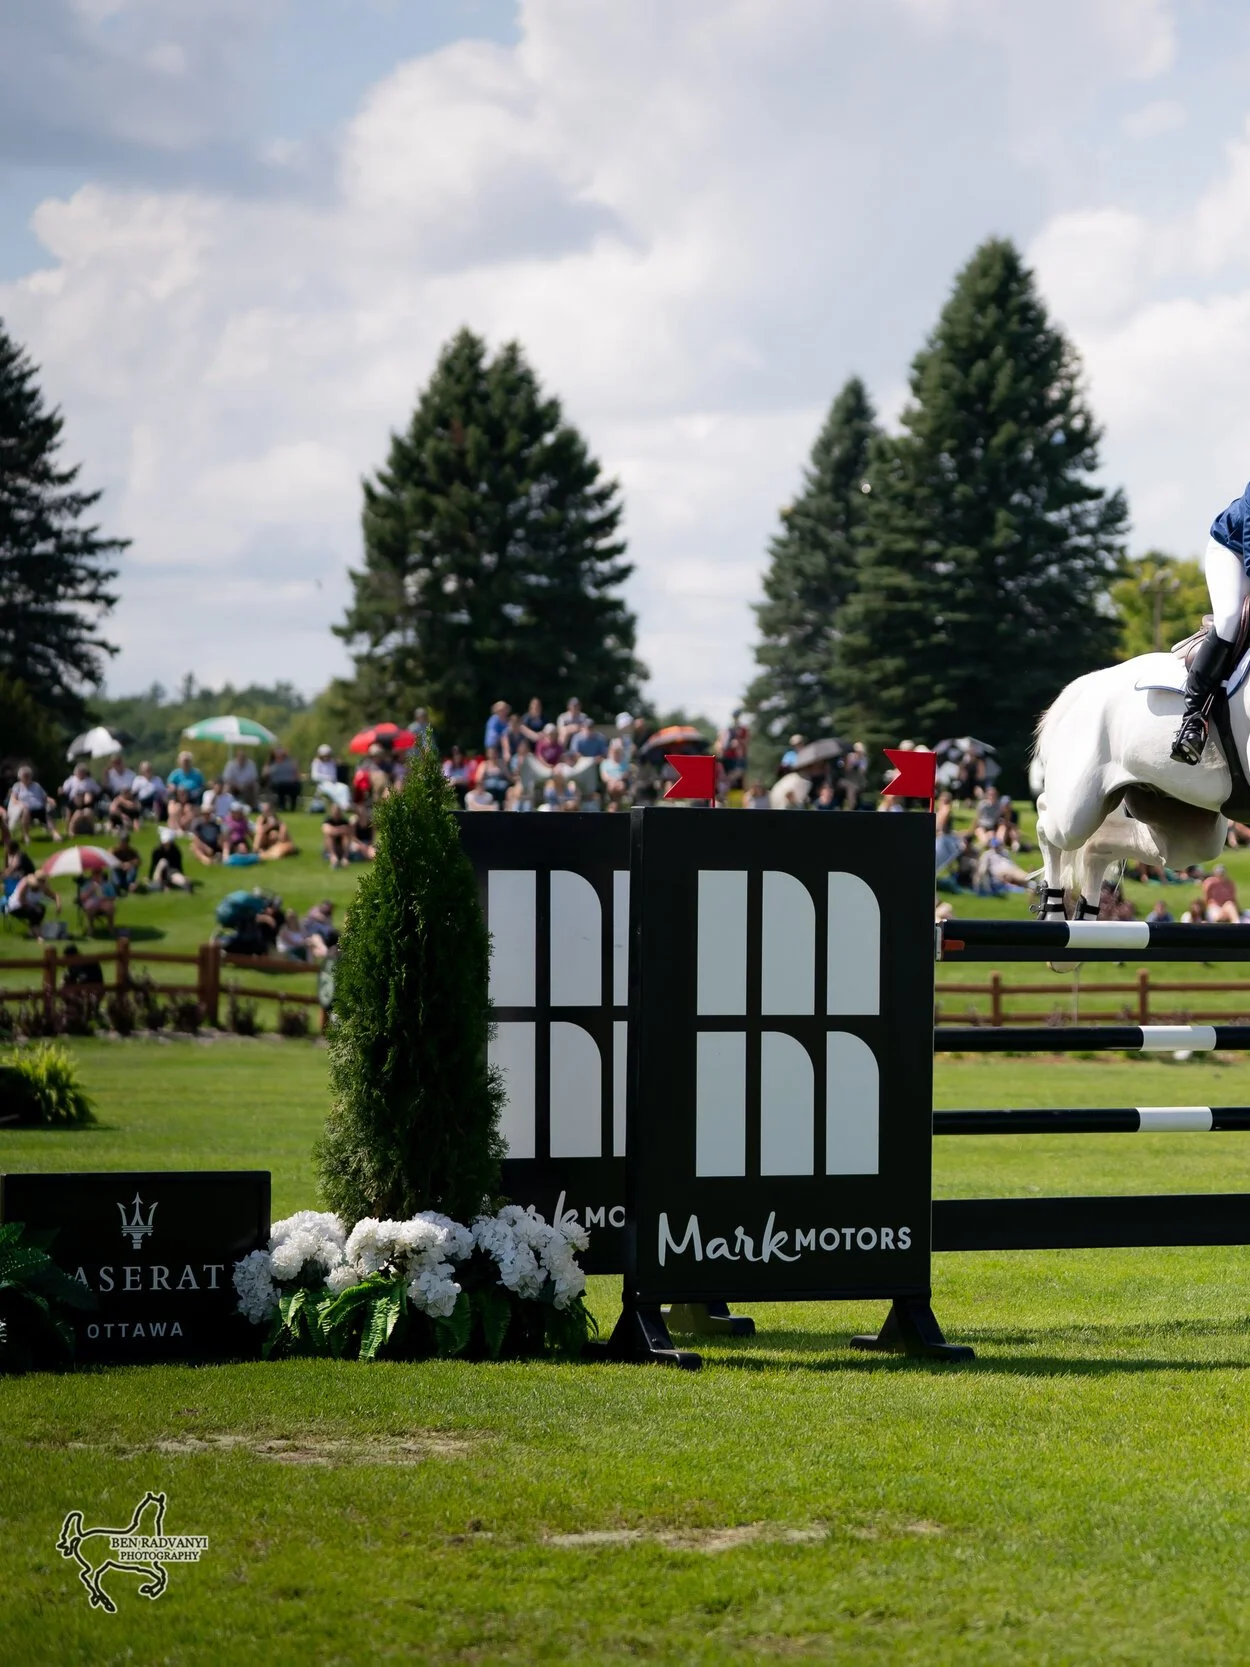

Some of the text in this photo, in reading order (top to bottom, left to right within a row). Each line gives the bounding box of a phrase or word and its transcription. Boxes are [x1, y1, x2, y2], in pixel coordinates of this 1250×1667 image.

[658, 1211, 912, 1267] Mark MOTORS
[87, 1322, 184, 1339] OTTAWA
